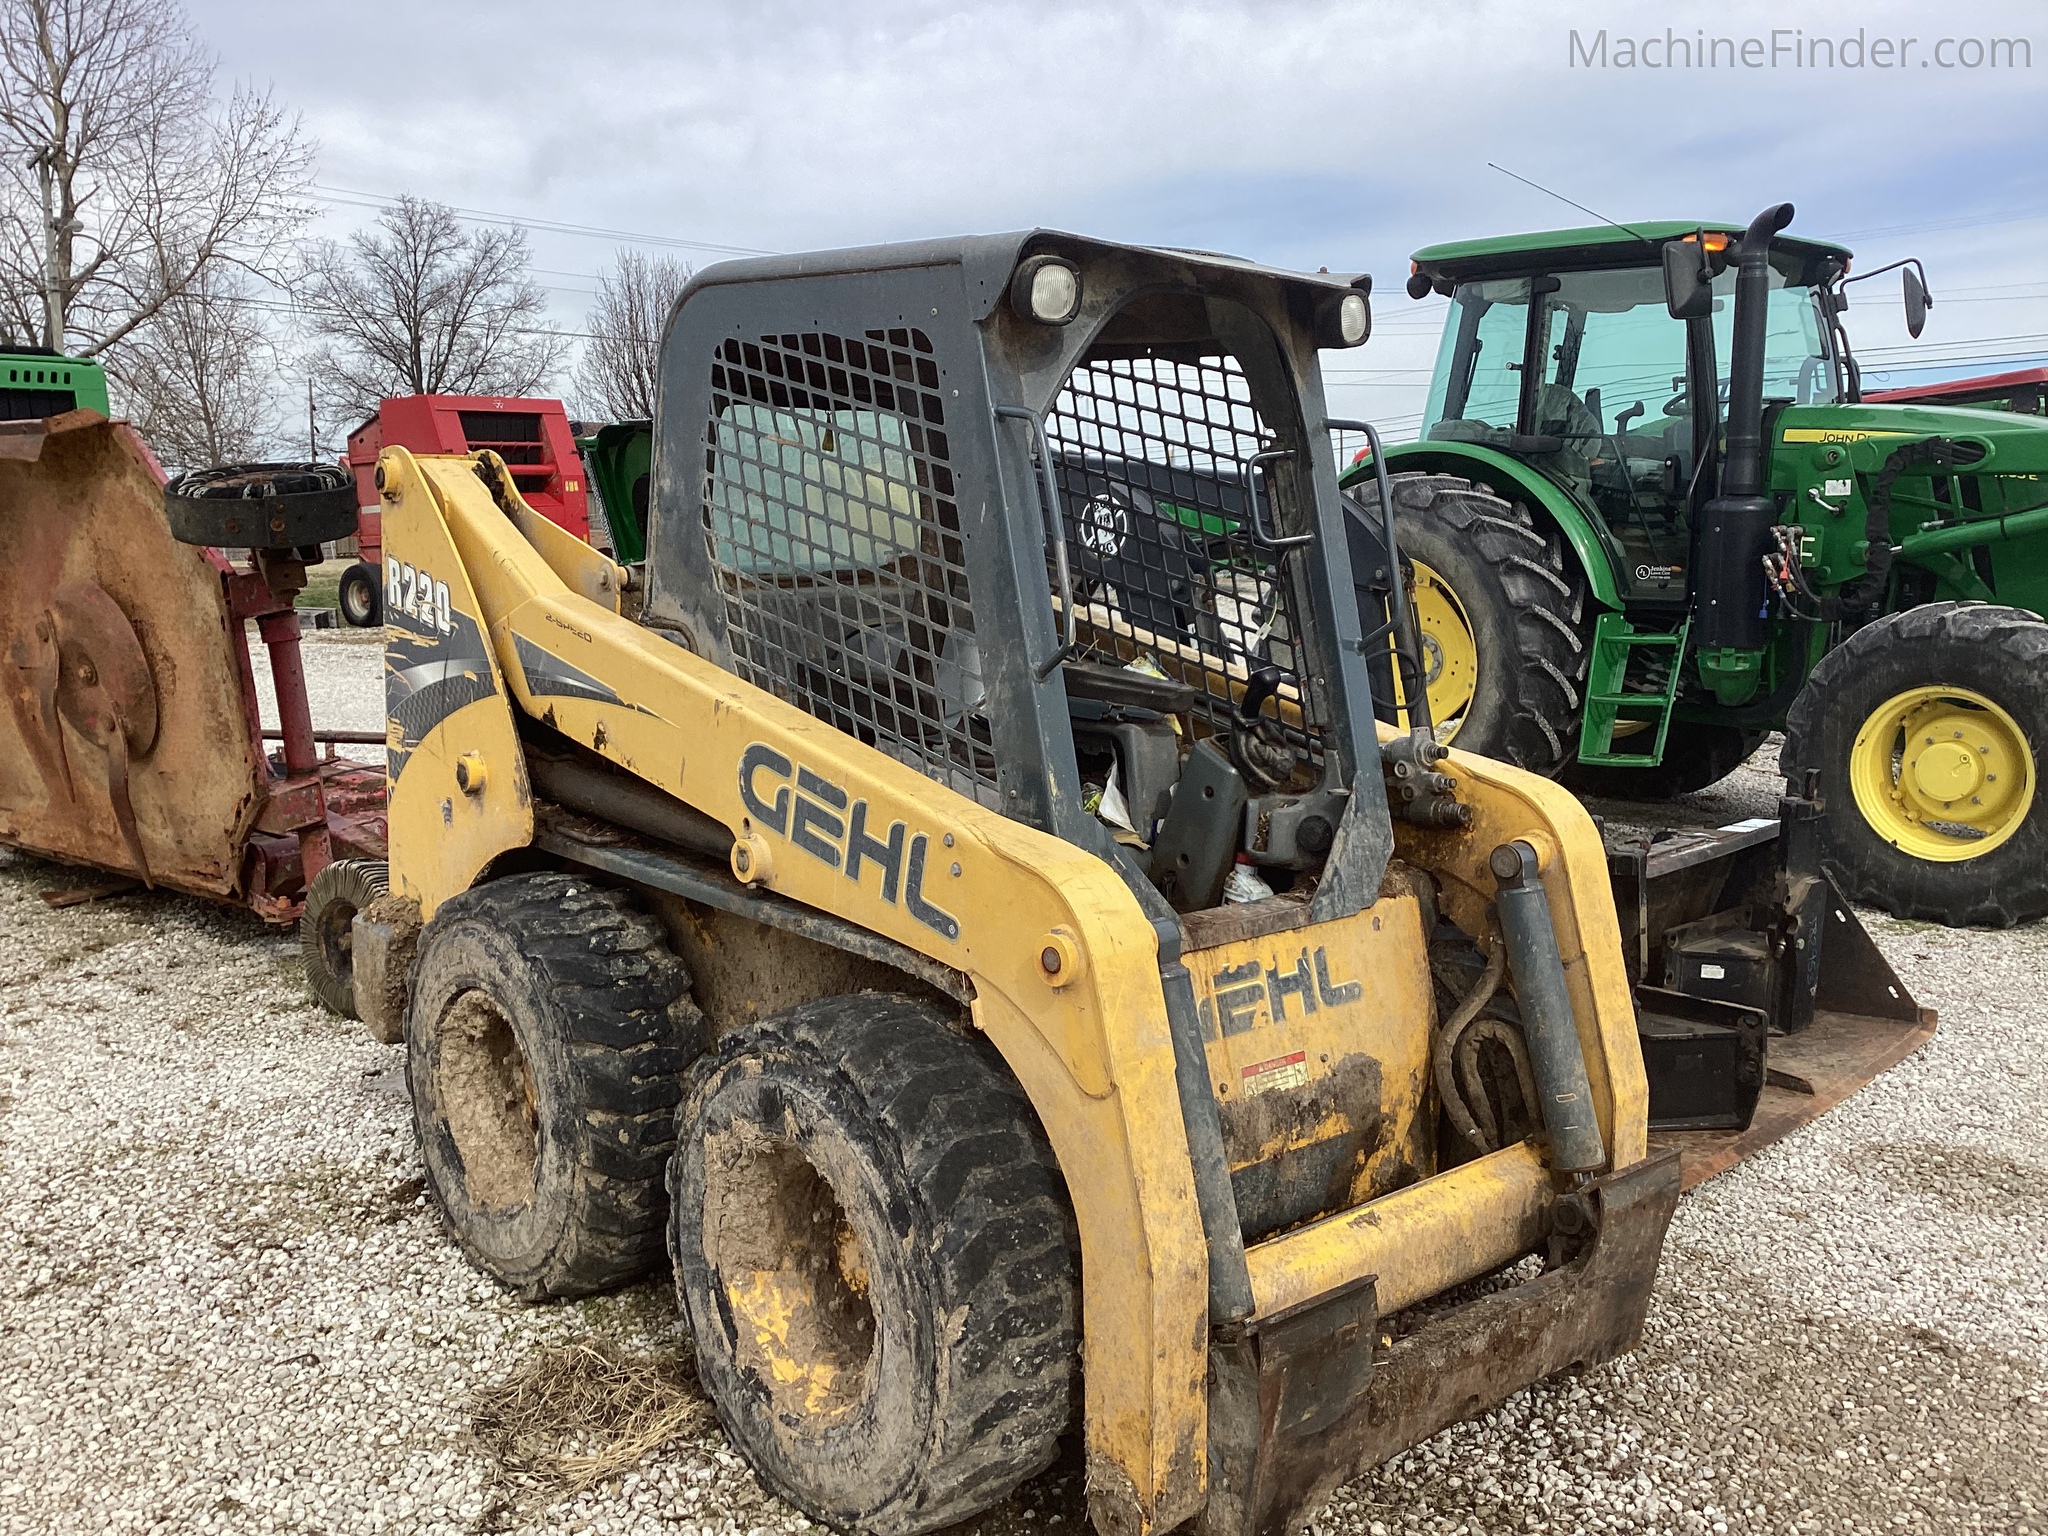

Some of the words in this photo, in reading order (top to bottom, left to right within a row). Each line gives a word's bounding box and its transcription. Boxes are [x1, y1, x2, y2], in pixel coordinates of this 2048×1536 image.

[1819, 432, 1854, 443] JOHN
[387, 553, 451, 636] R220
[737, 741, 962, 945] GEHL
